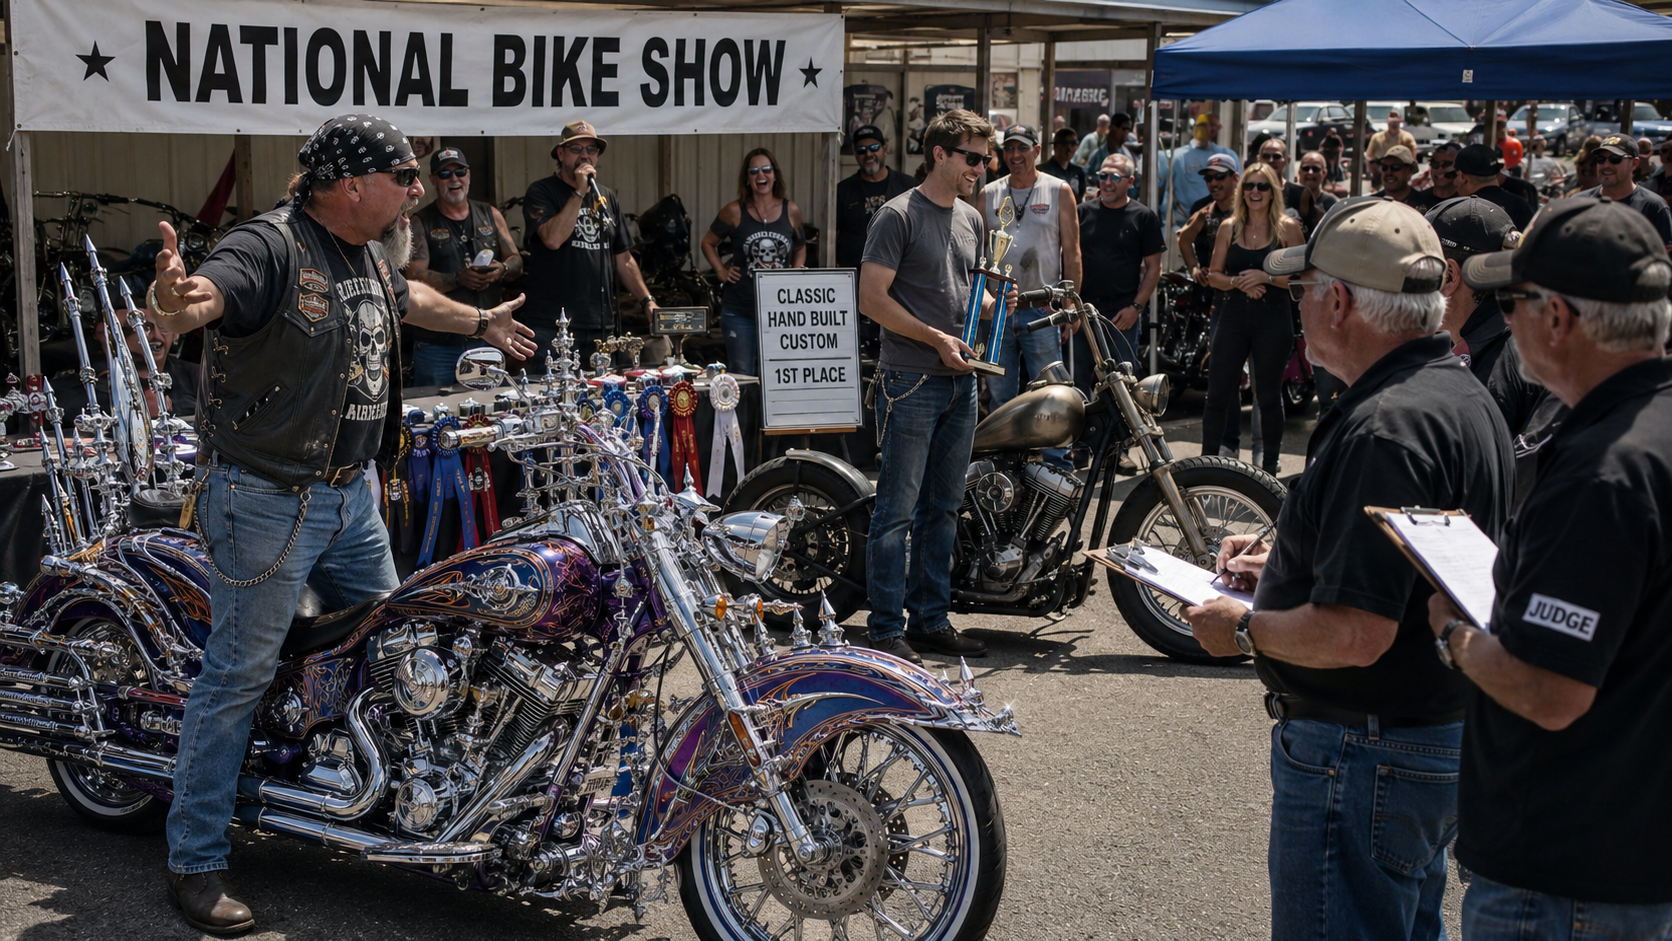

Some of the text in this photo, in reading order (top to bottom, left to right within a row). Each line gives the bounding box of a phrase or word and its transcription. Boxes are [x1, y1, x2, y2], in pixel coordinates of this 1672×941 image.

[145, 20, 787, 107] NATIONAL BIKE SHOW
[777, 288, 836, 304] CLASSIC
[768, 310, 848, 327] HAND BUILT
[780, 333, 838, 350] CUSTOM
[775, 366, 847, 384] 1ST PLACE
[1529, 601, 1594, 635] JUDGE
